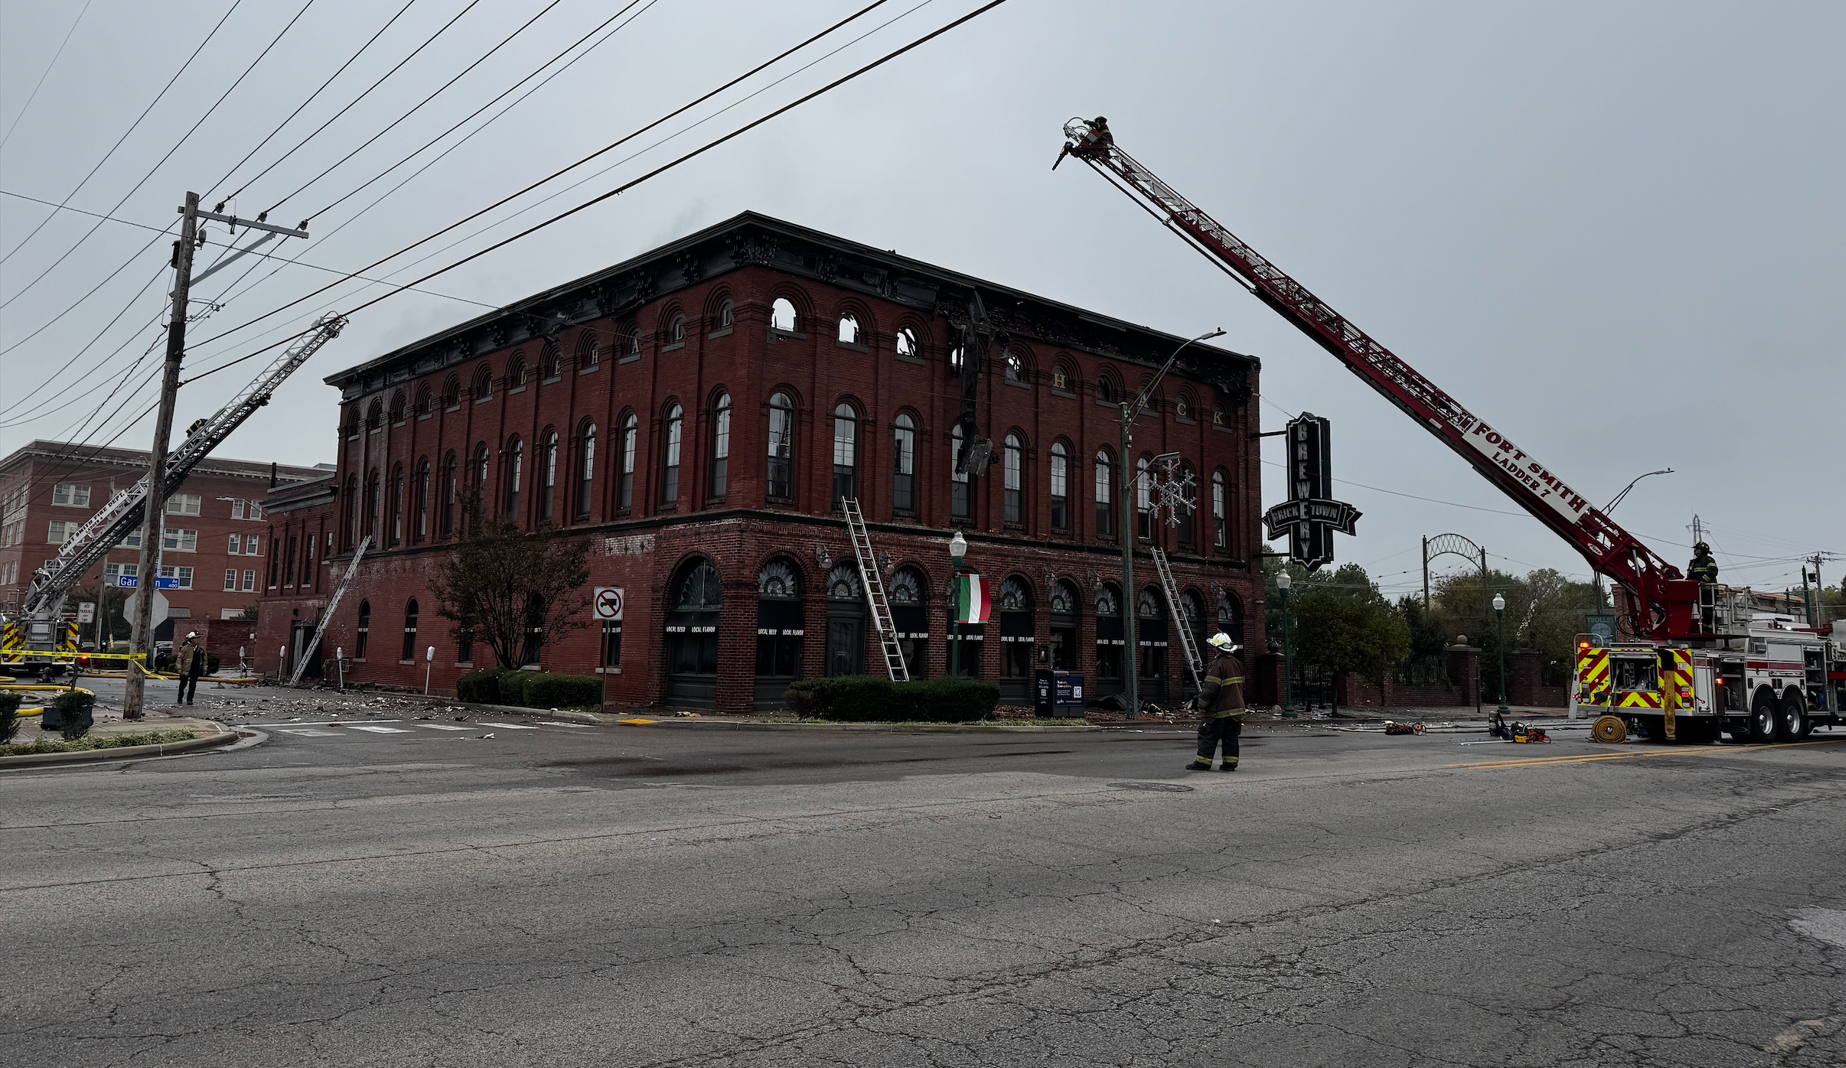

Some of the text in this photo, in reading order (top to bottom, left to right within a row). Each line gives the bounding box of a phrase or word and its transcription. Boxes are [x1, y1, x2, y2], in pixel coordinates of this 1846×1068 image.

[1472, 421, 1588, 513] FORT SMITH
[1492, 451, 1552, 498] LADDER 7
[1296, 422, 1311, 559] BREWERY
[1271, 505, 1338, 521] BRICK TOWN
[59, 537, 76, 552] FORT
[75, 519, 94, 537] SMITH
[120, 576, 161, 588] Garn
